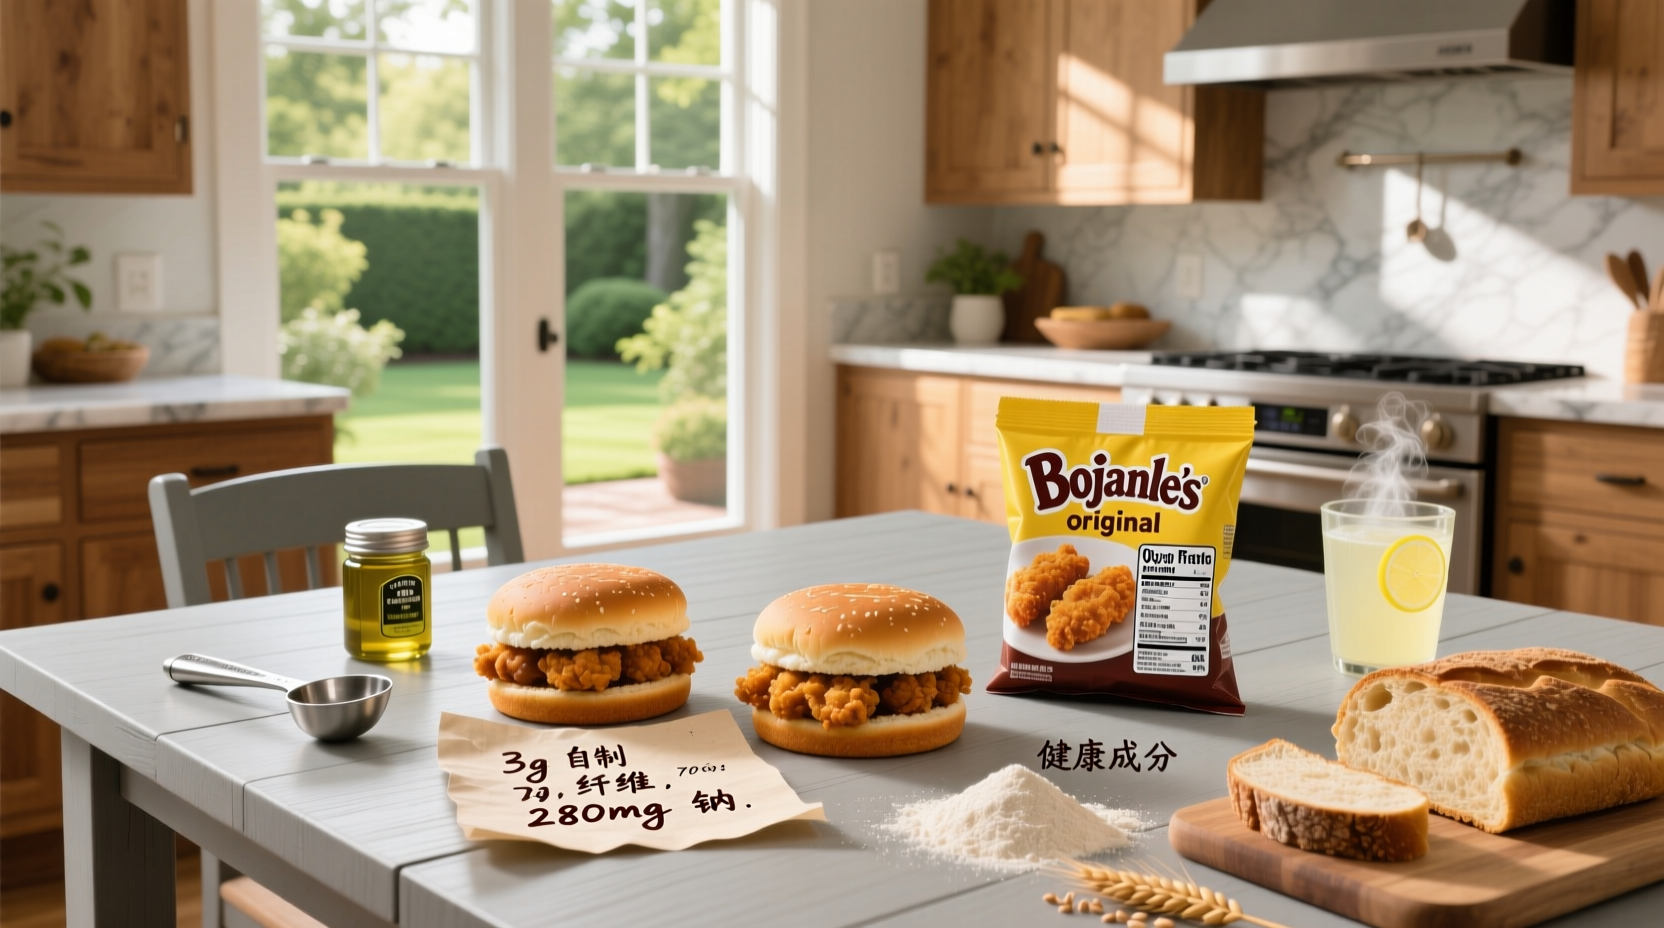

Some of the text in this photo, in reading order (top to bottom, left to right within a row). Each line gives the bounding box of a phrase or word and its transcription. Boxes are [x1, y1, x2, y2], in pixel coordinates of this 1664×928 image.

[1025, 452, 1202, 511] Bojanle's
[1066, 510, 1161, 537] original
[502, 744, 627, 784] 3g 自制
[527, 803, 673, 831] 280mg
